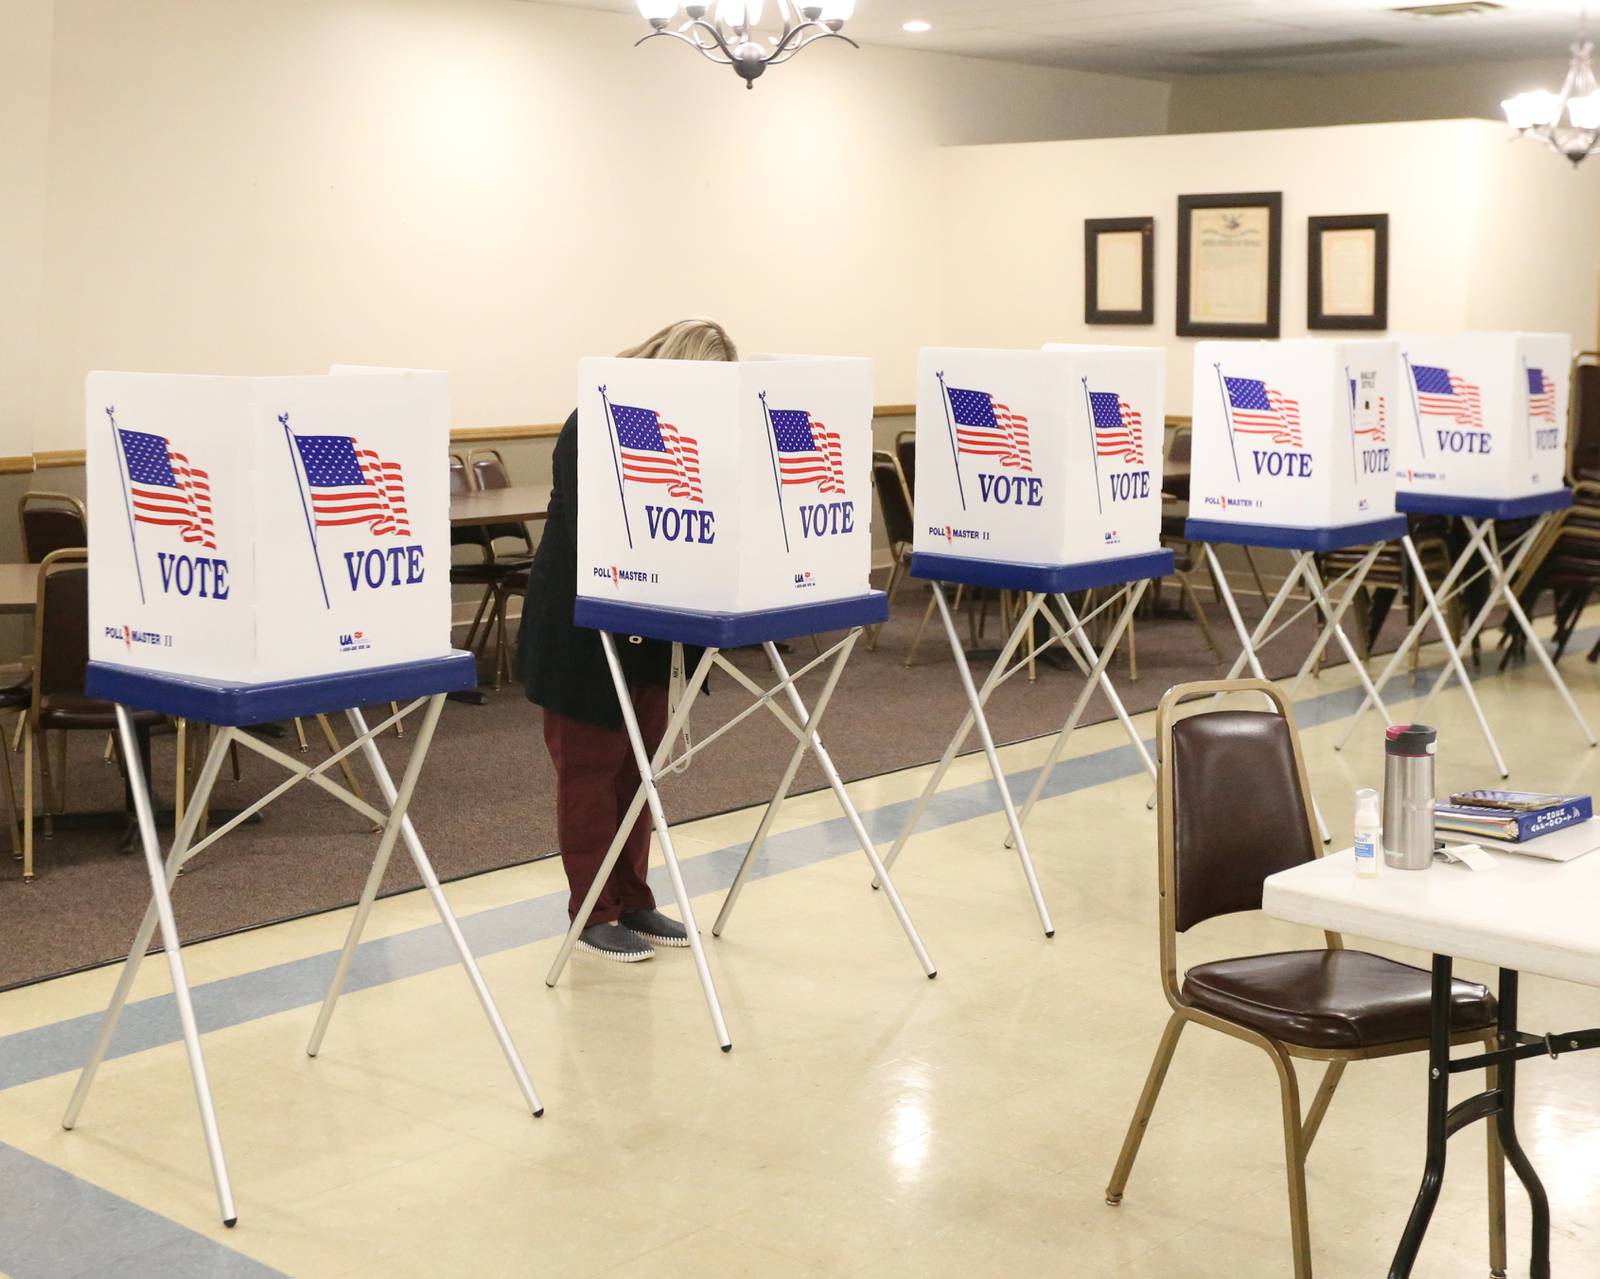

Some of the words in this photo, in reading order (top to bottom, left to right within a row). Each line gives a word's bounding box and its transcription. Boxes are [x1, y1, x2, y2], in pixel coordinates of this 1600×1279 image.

[1437, 430, 1493, 454] VOTE
[1252, 450, 1313, 478] VOTE
[1362, 448, 1390, 474] VOTE
[978, 473, 1044, 507] VOTE
[1109, 471, 1151, 502] VOTE
[1204, 496, 1220, 505] POLL
[1227, 498, 1253, 507] MASTER
[645, 504, 716, 545] VOTE
[799, 501, 855, 539] VOTE
[929, 526, 946, 537] POLL
[952, 529, 980, 540] MASTER
[158, 552, 230, 601] VOTE
[344, 544, 425, 592] VOTE
[593, 567, 611, 579] POLL
[618, 569, 648, 582] MASTER
[105, 626, 124, 640] POLL
[131, 629, 161, 646] MASTER
[339, 633, 353, 646] UA
[1530, 813, 1573, 833] AFFIDAVIT
[1537, 807, 1565, 823] BINDER
